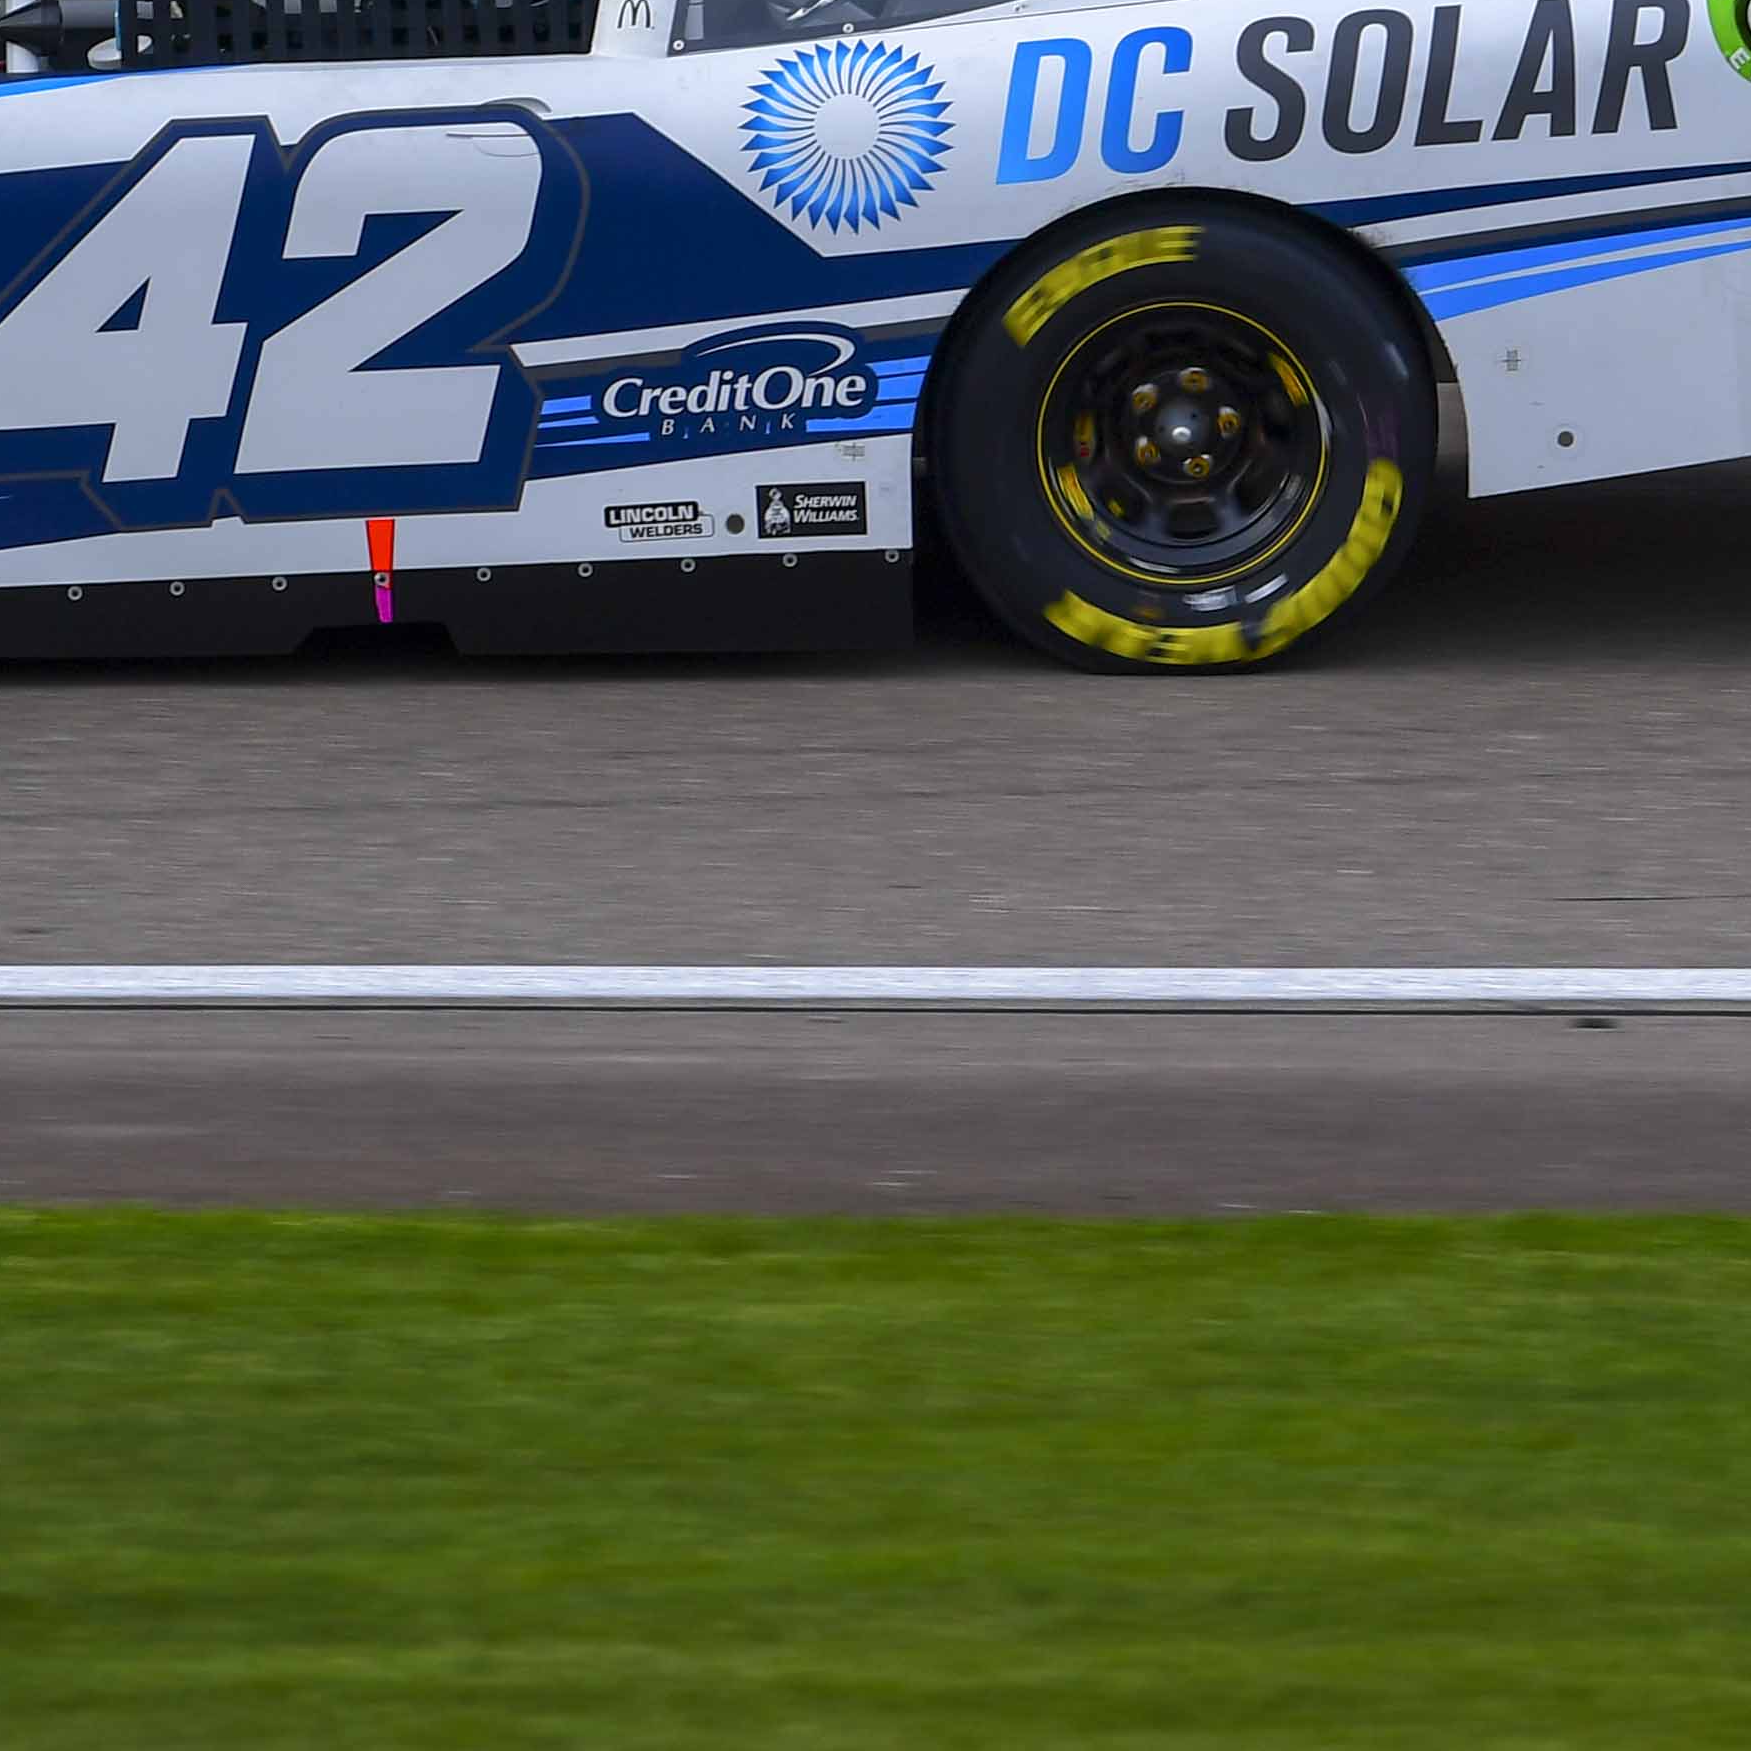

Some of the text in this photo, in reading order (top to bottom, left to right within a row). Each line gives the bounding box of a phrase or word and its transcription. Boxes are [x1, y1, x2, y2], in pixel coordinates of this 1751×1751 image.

[996, 24, 1193, 185] DC
[602, 365, 867, 419] CreditOne
[792, 493, 857, 509] SHERWIN
[608, 504, 696, 525] LINCOLN
[628, 522, 704, 539] WELDERS
